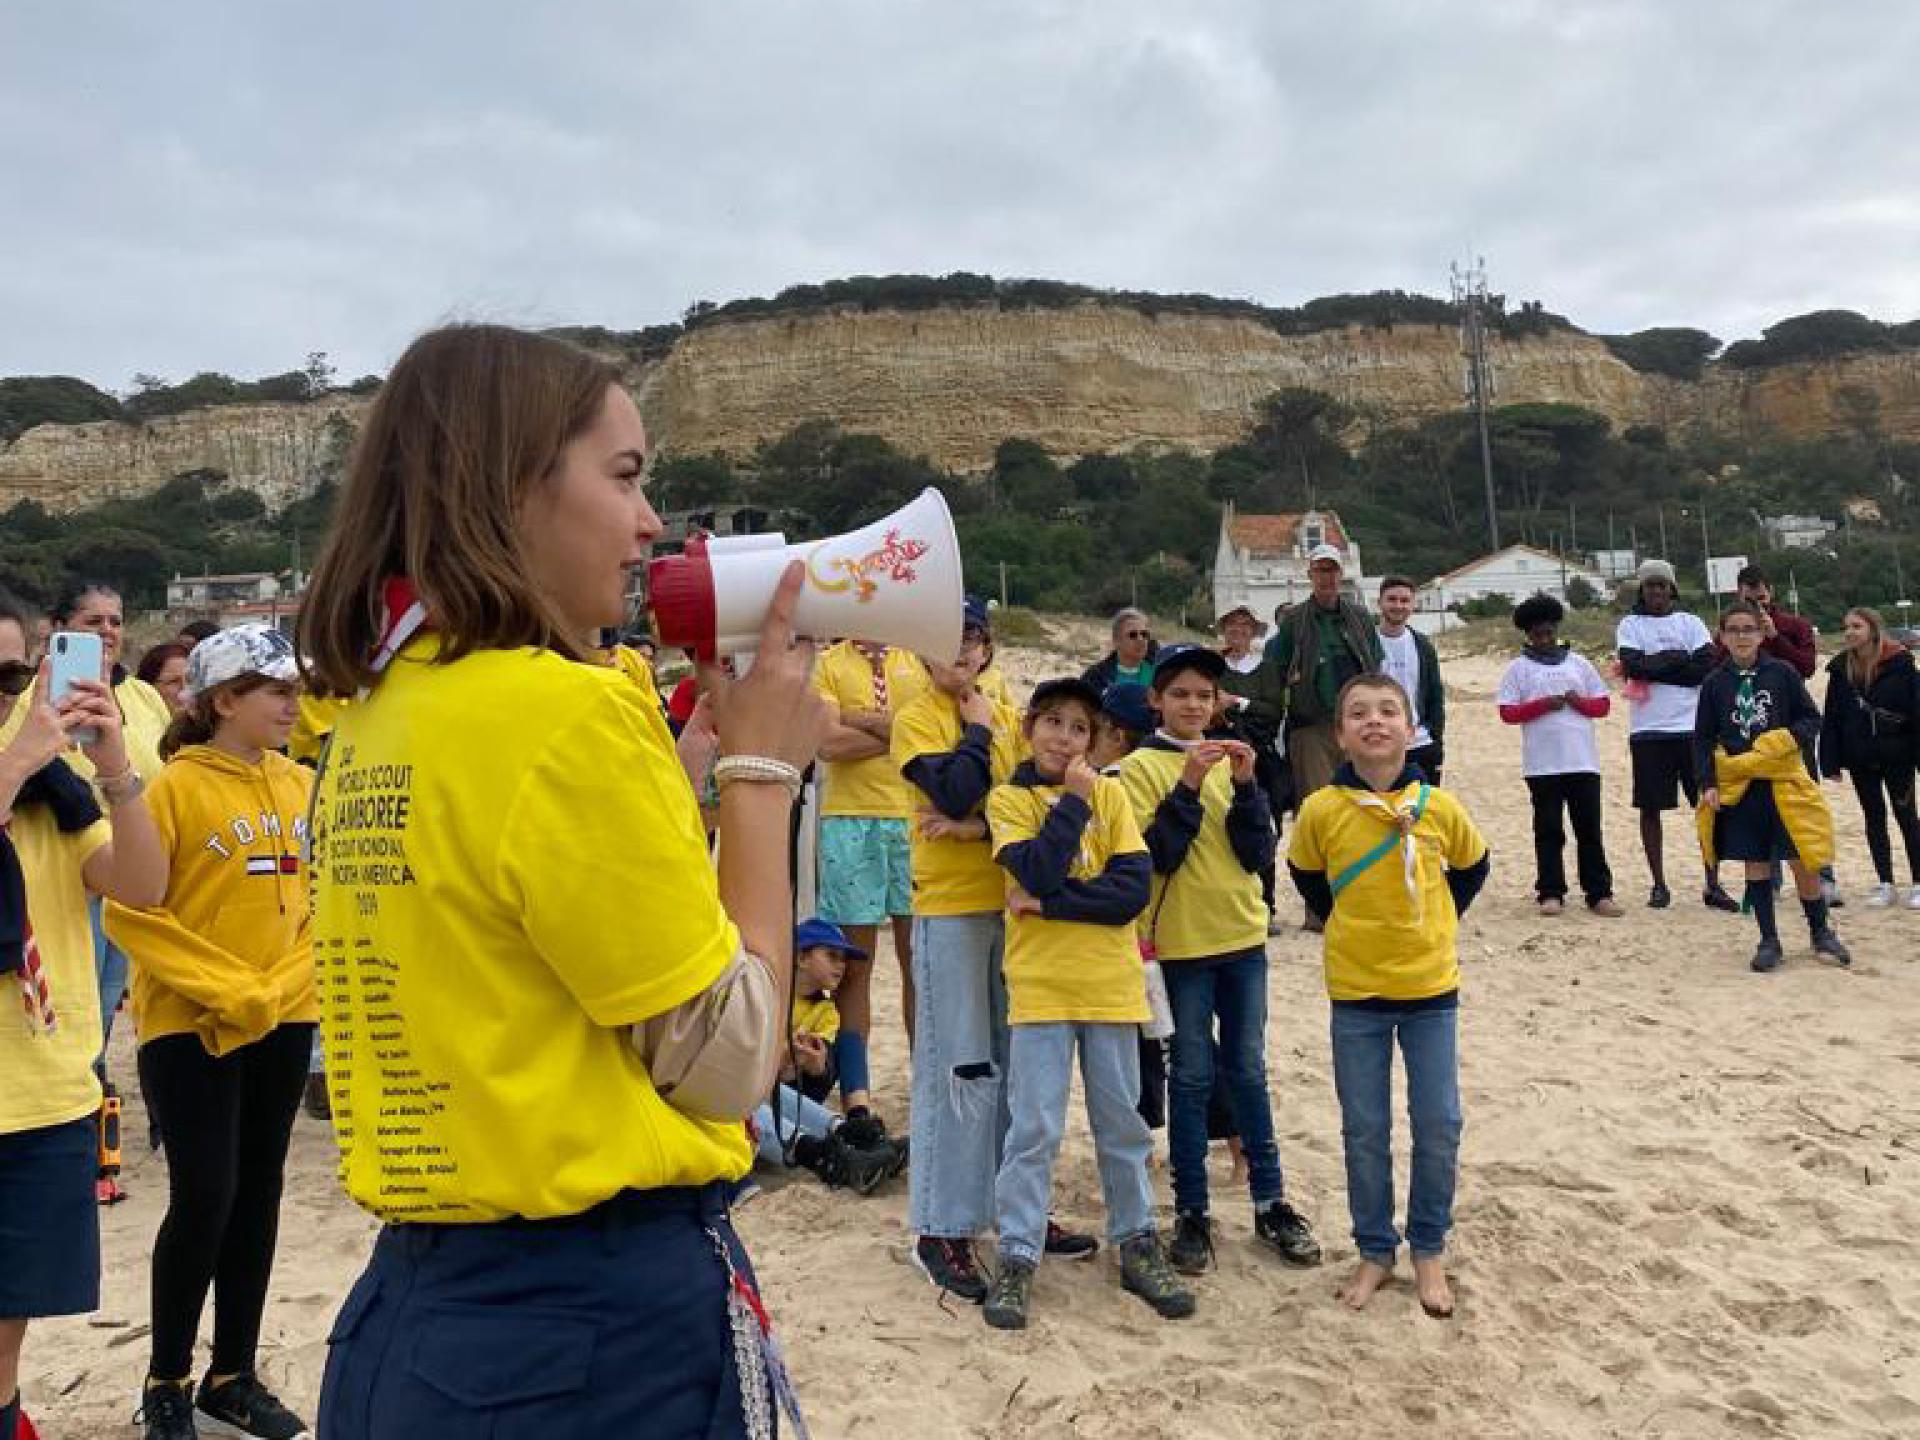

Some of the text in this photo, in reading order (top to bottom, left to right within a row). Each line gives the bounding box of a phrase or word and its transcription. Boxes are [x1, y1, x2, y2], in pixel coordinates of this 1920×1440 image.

[369, 764, 413, 790] SCOUT
[332, 795, 411, 833] JAMBOREE
[361, 864, 418, 886] AMERICA
